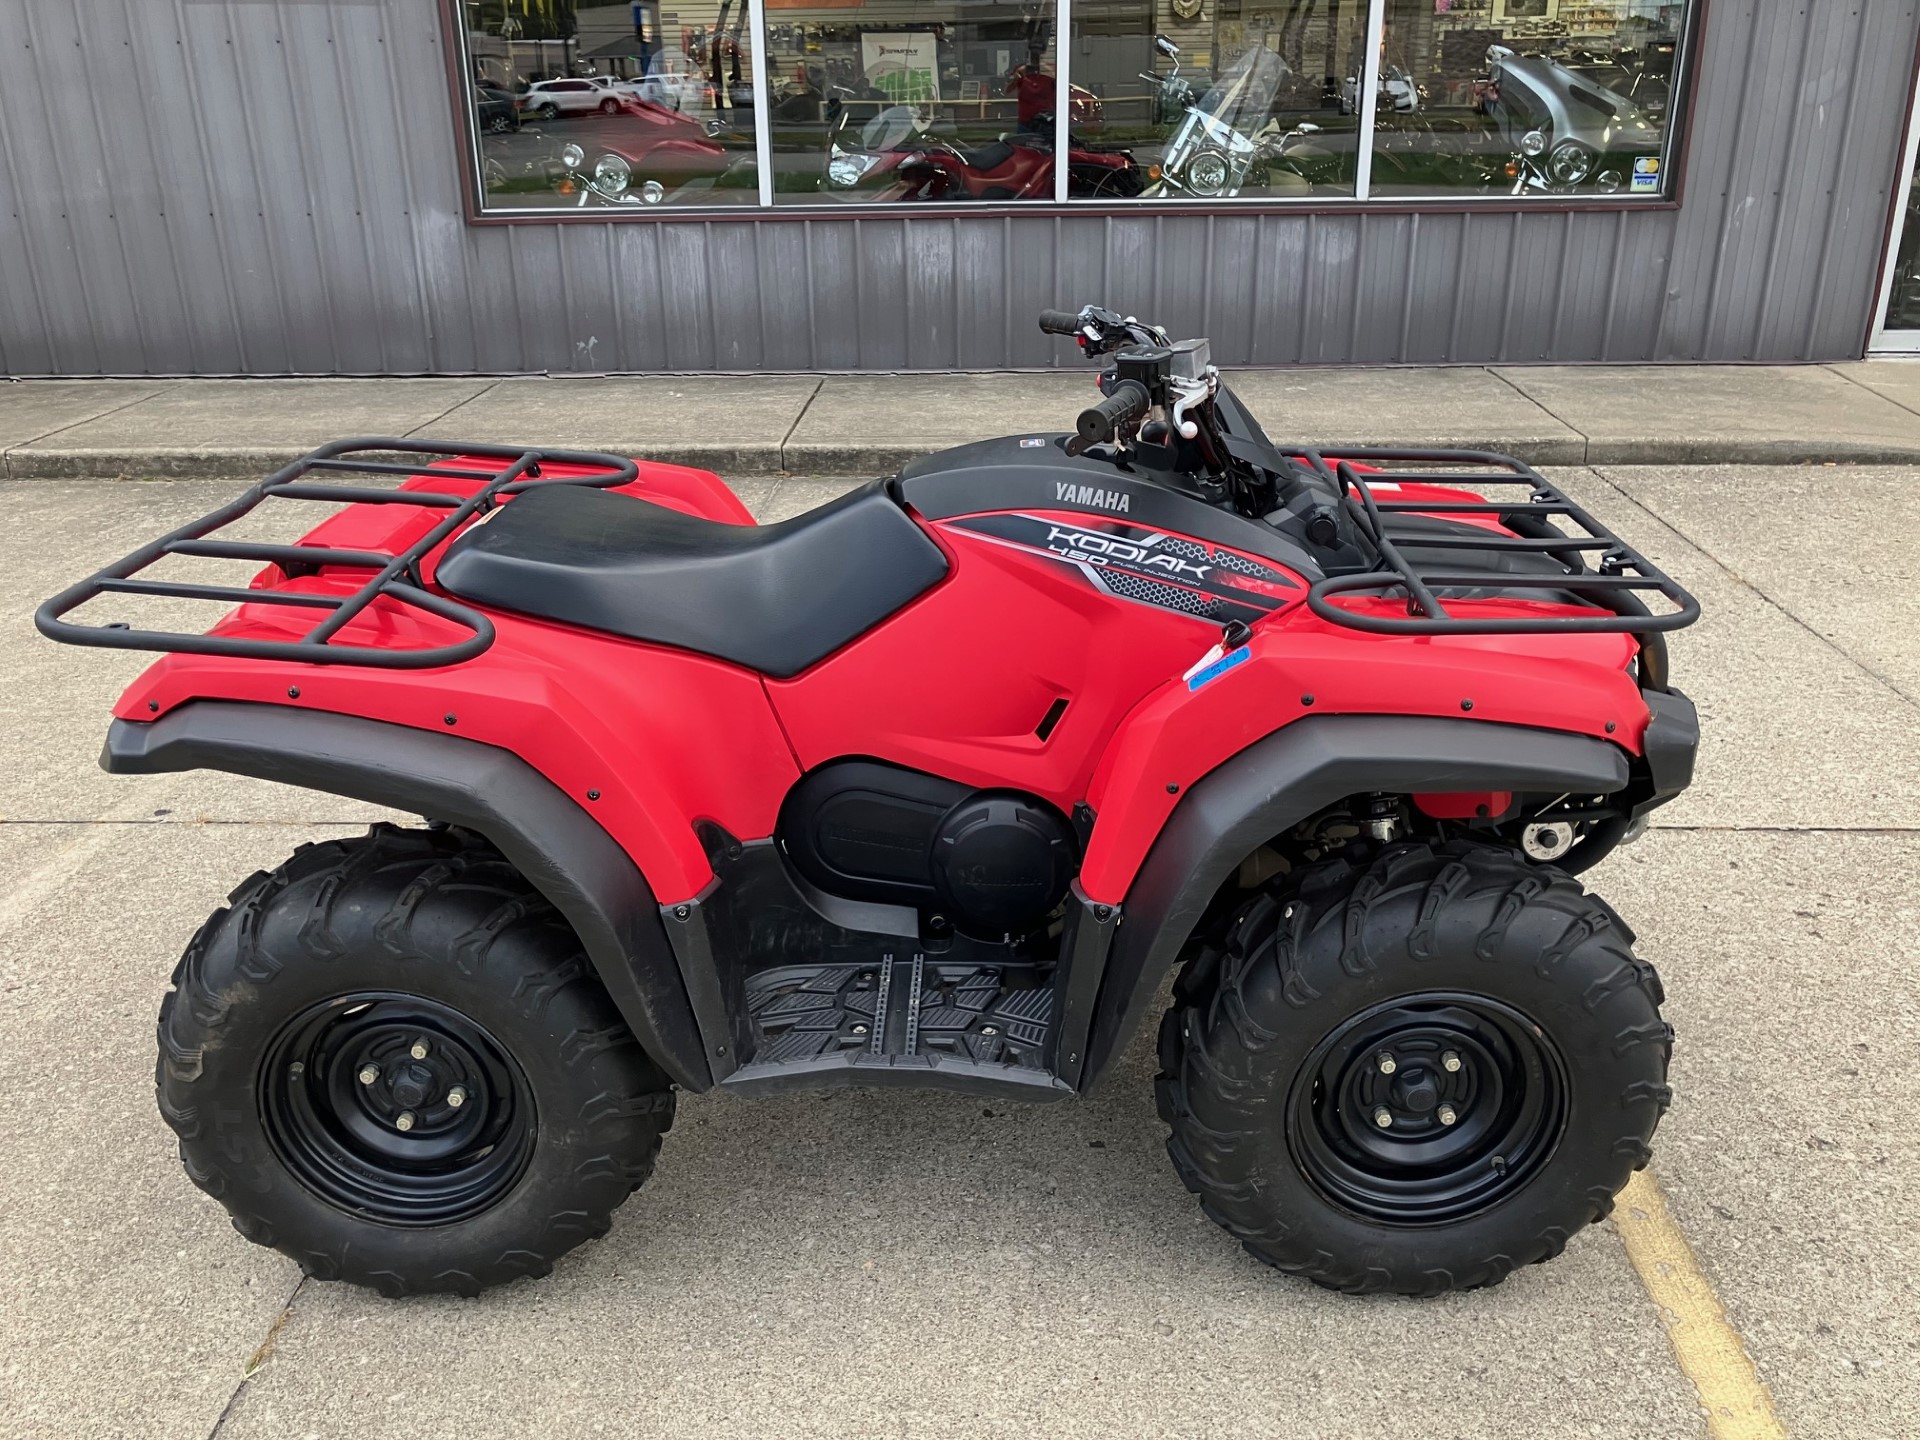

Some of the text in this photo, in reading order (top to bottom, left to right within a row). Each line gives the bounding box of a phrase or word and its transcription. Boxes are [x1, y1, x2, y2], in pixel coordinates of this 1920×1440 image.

[1056, 482, 1130, 513] YAMAHA
[1046, 526, 1213, 580] KODIAK
[1048, 544, 1109, 567] 450
[1112, 560, 1202, 587] FUEL INJECTION
